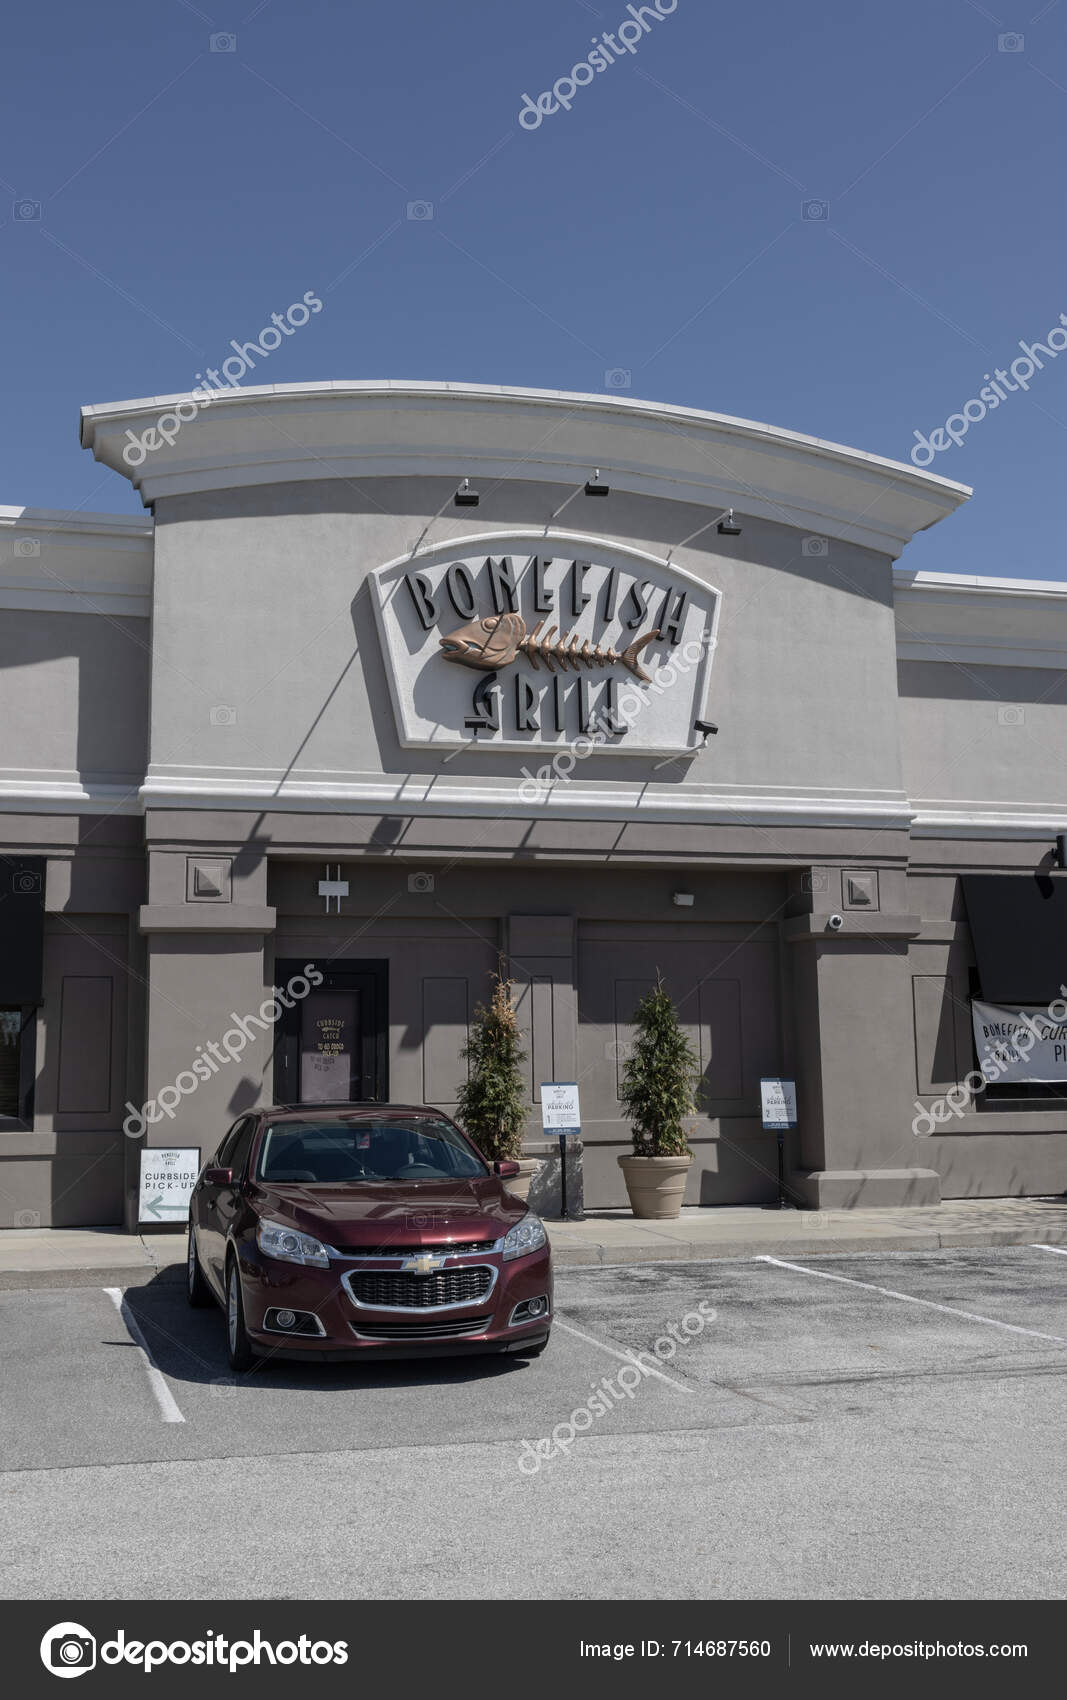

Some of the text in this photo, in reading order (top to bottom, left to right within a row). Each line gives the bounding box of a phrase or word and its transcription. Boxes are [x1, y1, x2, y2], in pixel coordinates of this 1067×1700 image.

[404, 555, 689, 645] BONEFISH
[473, 671, 628, 735] GRILL
[145, 1172, 196, 1181] CURBSIDE
[145, 1182, 196, 1190] PICK-UP
